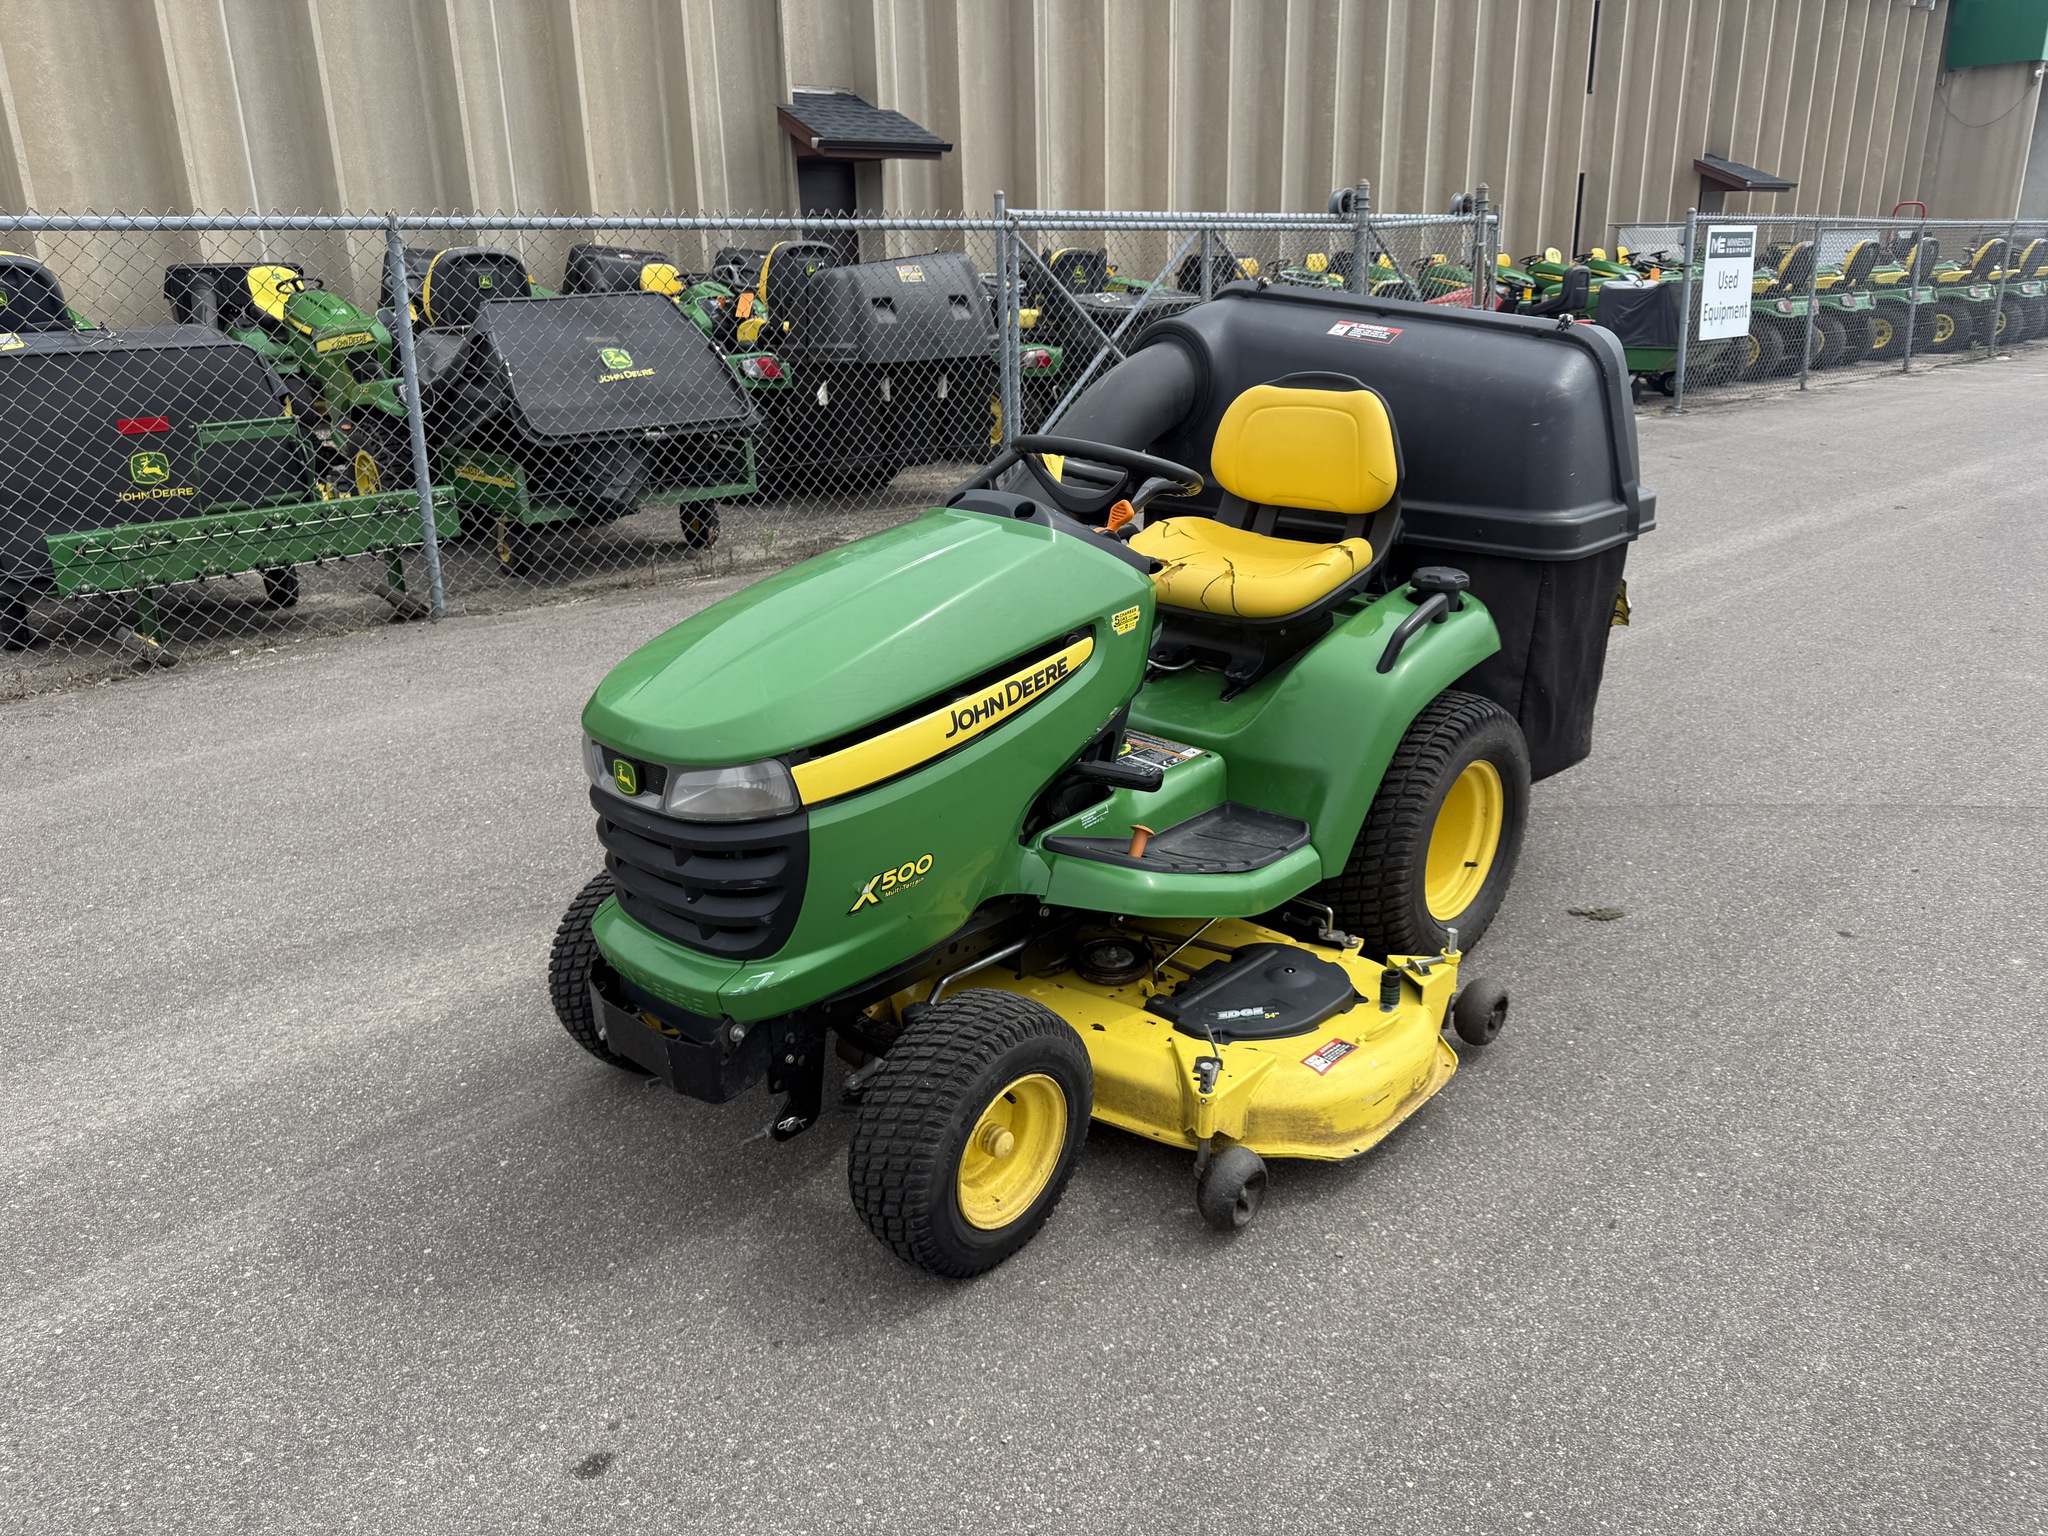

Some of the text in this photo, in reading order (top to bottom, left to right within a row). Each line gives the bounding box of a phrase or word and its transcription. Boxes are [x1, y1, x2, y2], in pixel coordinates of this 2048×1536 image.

[1718, 268, 1739, 289] Used
[1703, 301, 1748, 326] Equipment
[599, 373, 625, 384] JOHN
[115, 487, 194, 502] JOHN DEERE
[945, 656, 1069, 739] JOHN DEERE
[846, 852, 935, 915] X500
[884, 877, 925, 898] Multi-Terrain
